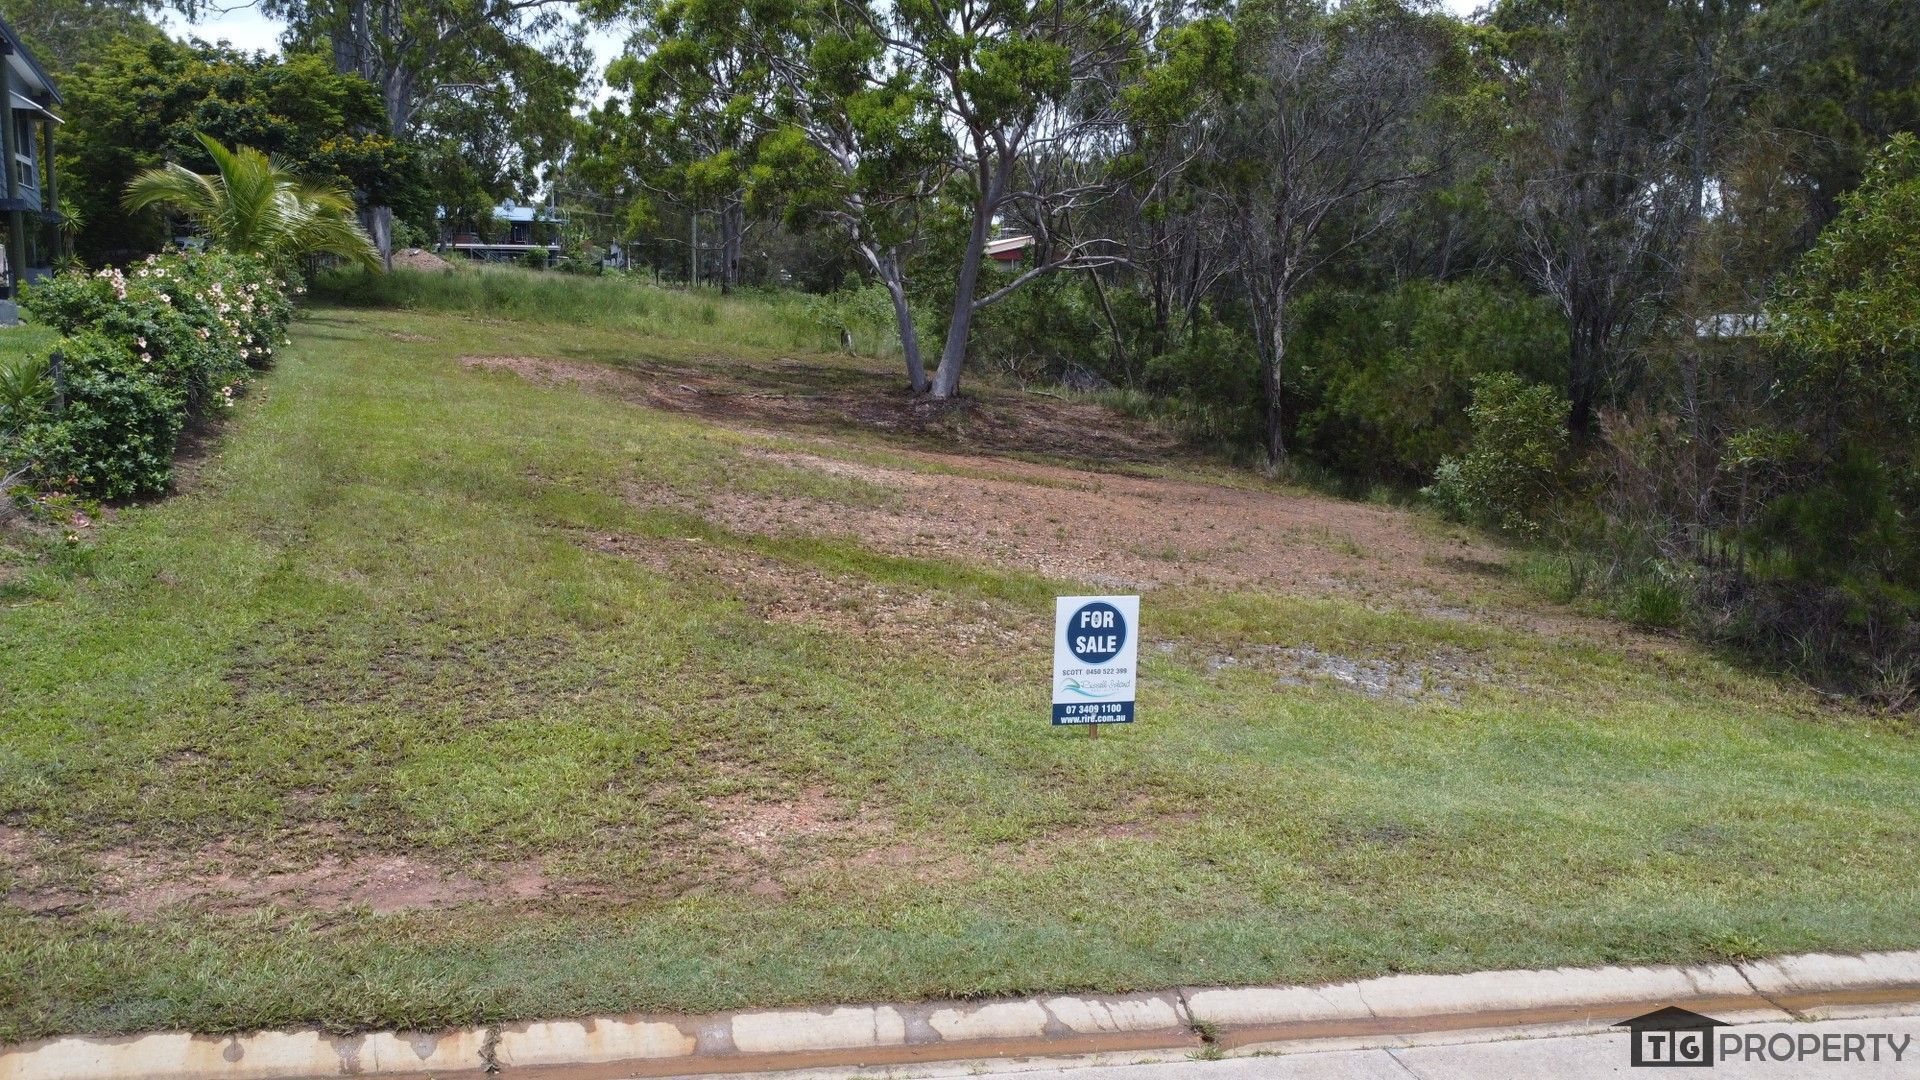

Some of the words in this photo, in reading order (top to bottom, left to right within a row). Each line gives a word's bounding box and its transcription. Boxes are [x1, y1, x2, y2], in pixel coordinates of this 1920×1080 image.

[1081, 611, 1114, 628] FOR
[1076, 635, 1117, 653] SALE
[1066, 705, 1076, 714] 07
[1079, 704, 1099, 714] 3409
[1102, 704, 1121, 713] 1100
